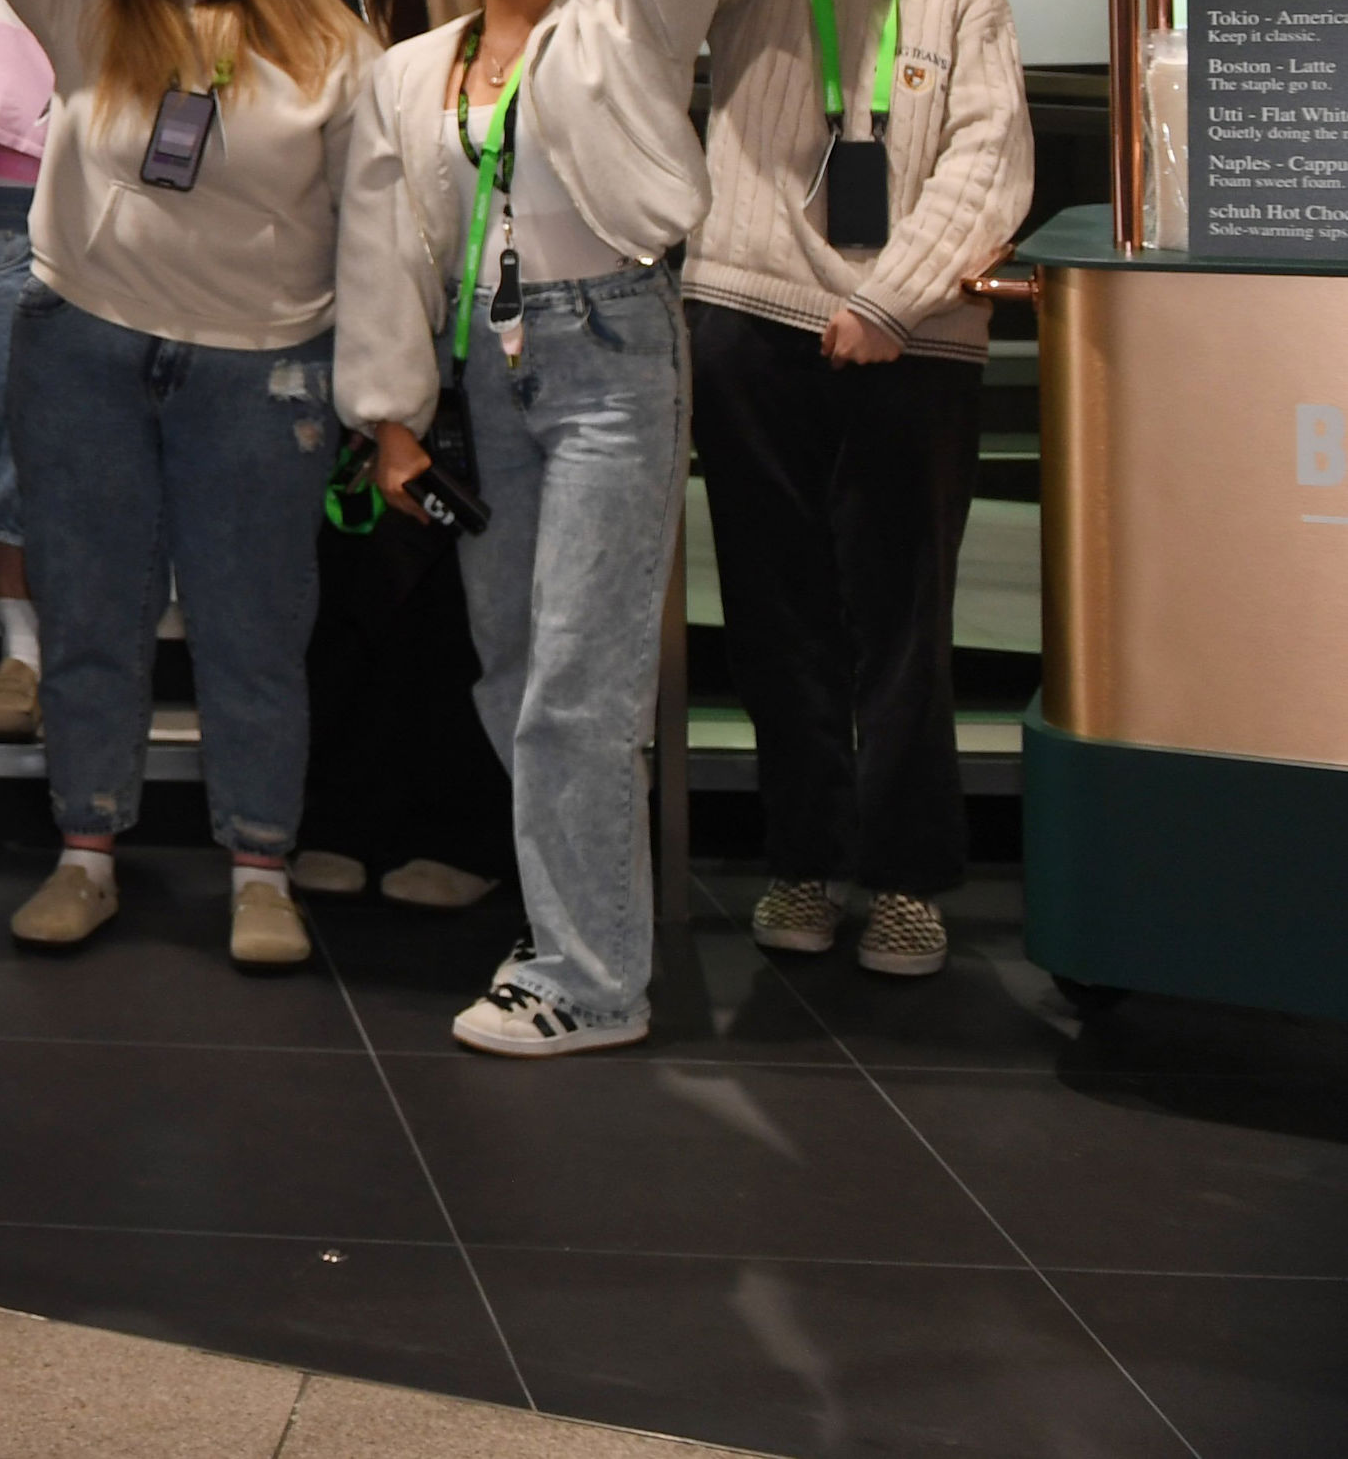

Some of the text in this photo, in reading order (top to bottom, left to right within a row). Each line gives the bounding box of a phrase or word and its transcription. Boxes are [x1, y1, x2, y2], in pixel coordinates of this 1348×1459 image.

[1207, 11, 1259, 25] Tokio
[1208, 29, 1321, 45] Keep it classic.
[1208, 59, 1271, 73] Boston
[1289, 59, 1336, 73] Latte
[1208, 78, 1332, 94] The staple go to.
[1208, 107, 1243, 122] Utti
[1261, 107, 1296, 122] Flat
[1208, 126, 1263, 141] Quietly
[1268, 126, 1311, 142] doing
[1315, 128, 1338, 139] the
[1209, 155, 1271, 174] Naples
[1209, 175, 1346, 188] Foam sweet foam.
[1209, 204, 1261, 219] schuh
[1267, 205, 1301, 219] Hot
[1209, 222, 1314, 240] Sole-warming
